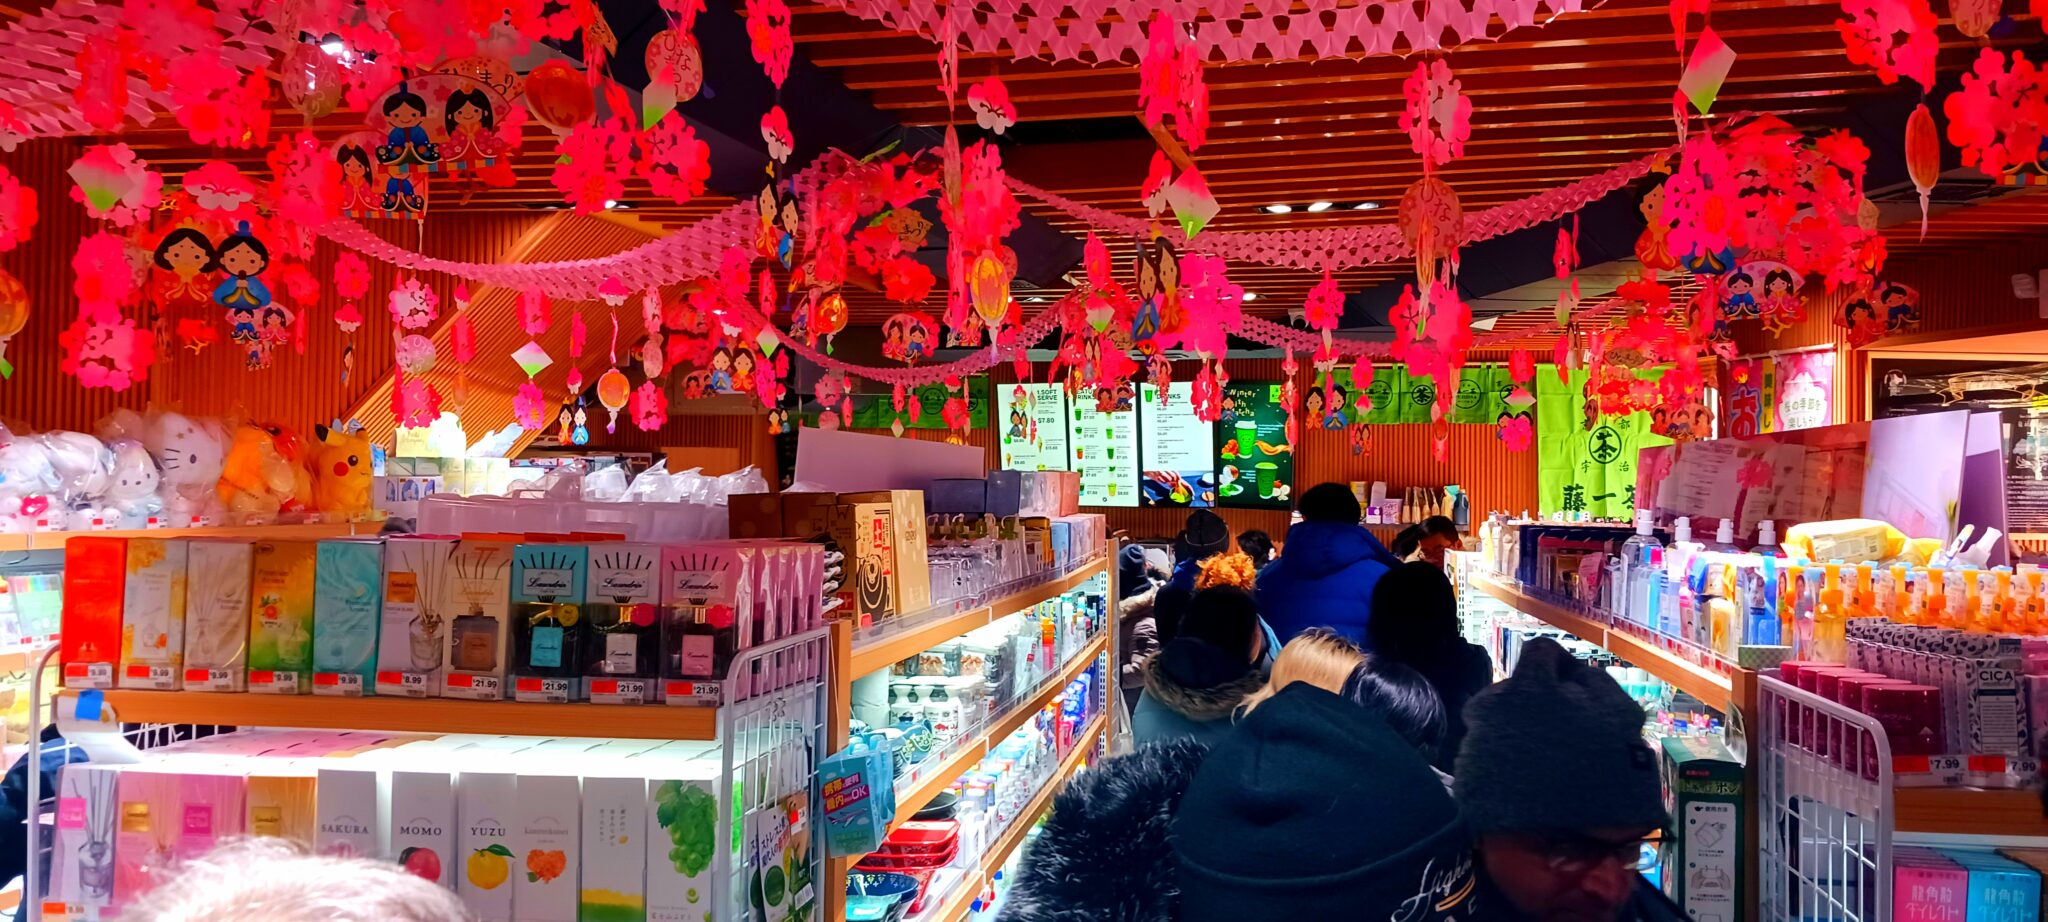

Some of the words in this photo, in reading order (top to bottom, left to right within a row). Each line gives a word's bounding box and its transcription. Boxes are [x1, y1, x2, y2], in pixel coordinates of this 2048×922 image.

[1592, 430, 1618, 460] 茶
[1979, 670, 2014, 682] CICA
[473, 678, 497, 689] $21.99
[543, 683, 568, 691] $21.99
[617, 684, 643, 693] $21.99
[694, 686, 719, 695] $21.99
[1930, 759, 1960, 770] $7.99
[321, 824, 369, 834] SAKURA
[400, 826, 442, 836] MOMO
[471, 827, 506, 837] YUZU
